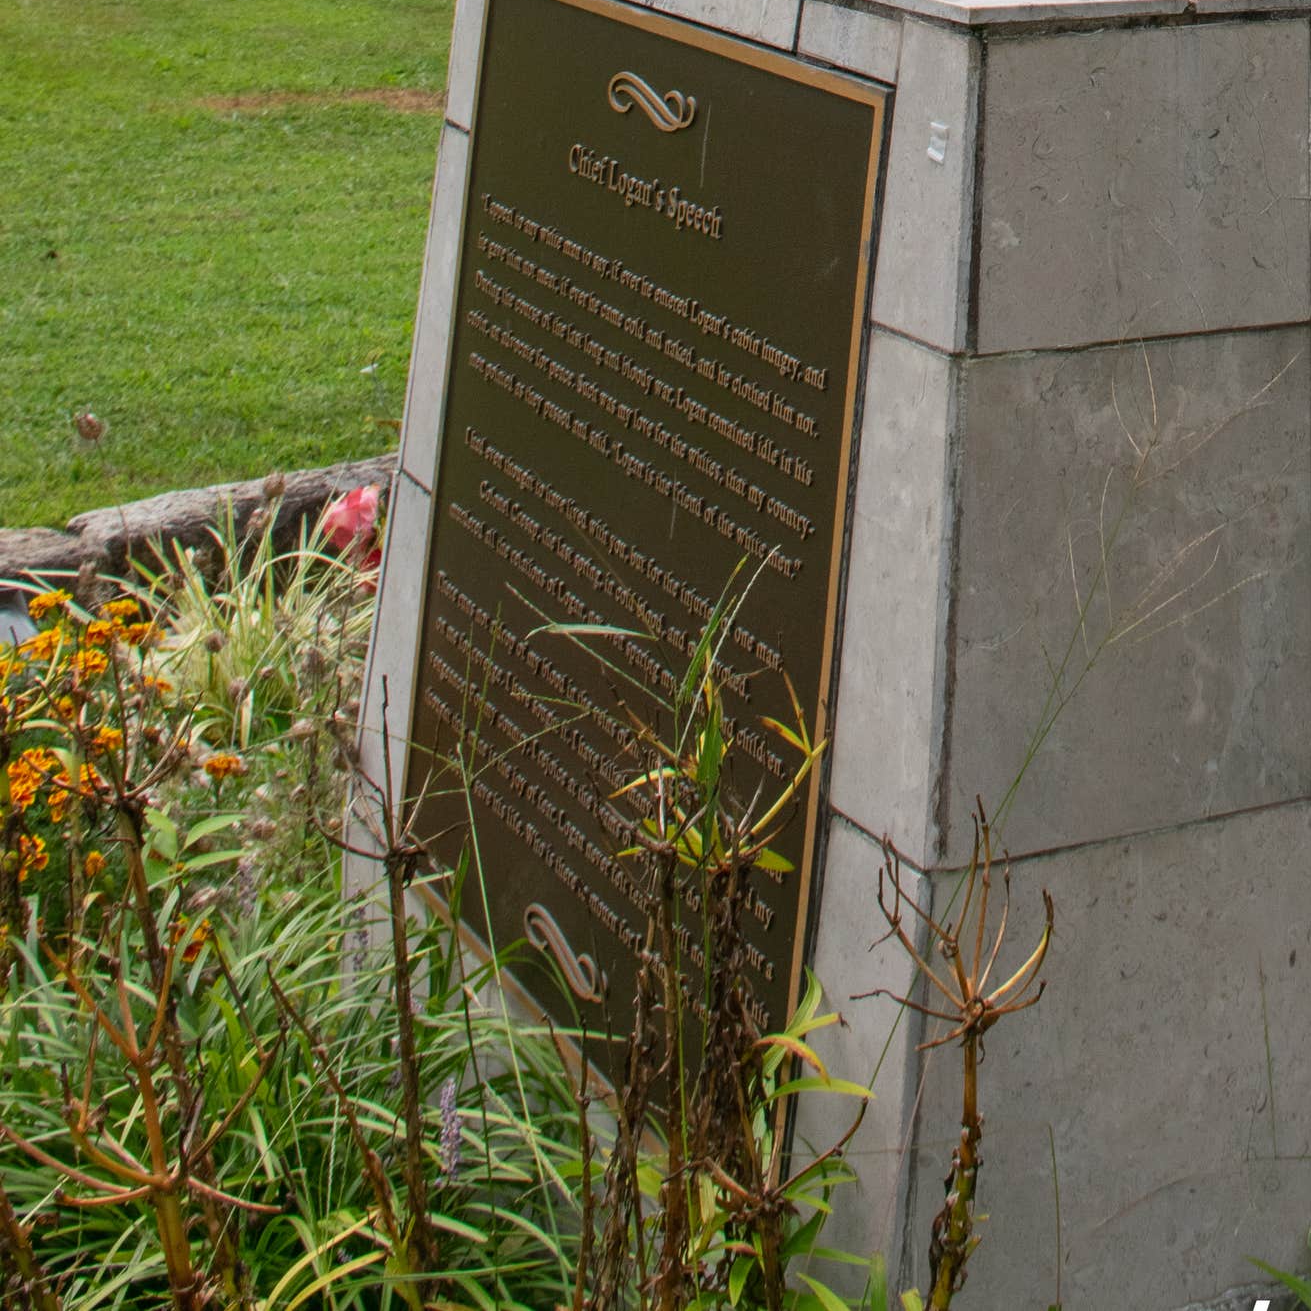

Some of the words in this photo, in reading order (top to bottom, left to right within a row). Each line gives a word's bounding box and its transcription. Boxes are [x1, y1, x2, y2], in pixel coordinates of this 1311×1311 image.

[569, 142, 610, 185] Chief
[608, 159, 666, 212] Logan's
[667, 187, 724, 240] Speech
[641, 276, 655, 297] he
[654, 288, 690, 316] entered
[690, 302, 730, 338] Logan's
[732, 329, 761, 354] cabin
[805, 368, 827, 390] and
[646, 330, 665, 348] and
[698, 359, 718, 378] and
[718, 364, 733, 387] he
[732, 376, 772, 409] clothed
[772, 395, 795, 422] him
[622, 357, 654, 394] bloody
[676, 389, 707, 421] Logan
[708, 413, 757, 450] remained
[757, 436, 779, 464] idle
[780, 450, 794, 473] in
[794, 459, 815, 486] his
[633, 409, 655, 437] love
[655, 423, 671, 447] for
[671, 435, 688, 458] the
[726, 470, 748, 496] that
[748, 486, 767, 514] my
[767, 498, 816, 541] country-
[646, 463, 656, 483] is
[655, 472, 674, 495] the
[673, 480, 705, 515] friend
[704, 506, 719, 525] of
[718, 513, 736, 537] the
[736, 527, 768, 558] white
[630, 546, 649, 572] but
[647, 558, 665, 584] for
[663, 572, 679, 595] the
[679, 581, 718, 623] injurie
[734, 626, 756, 651] one
[717, 708, 737, 738] nd
